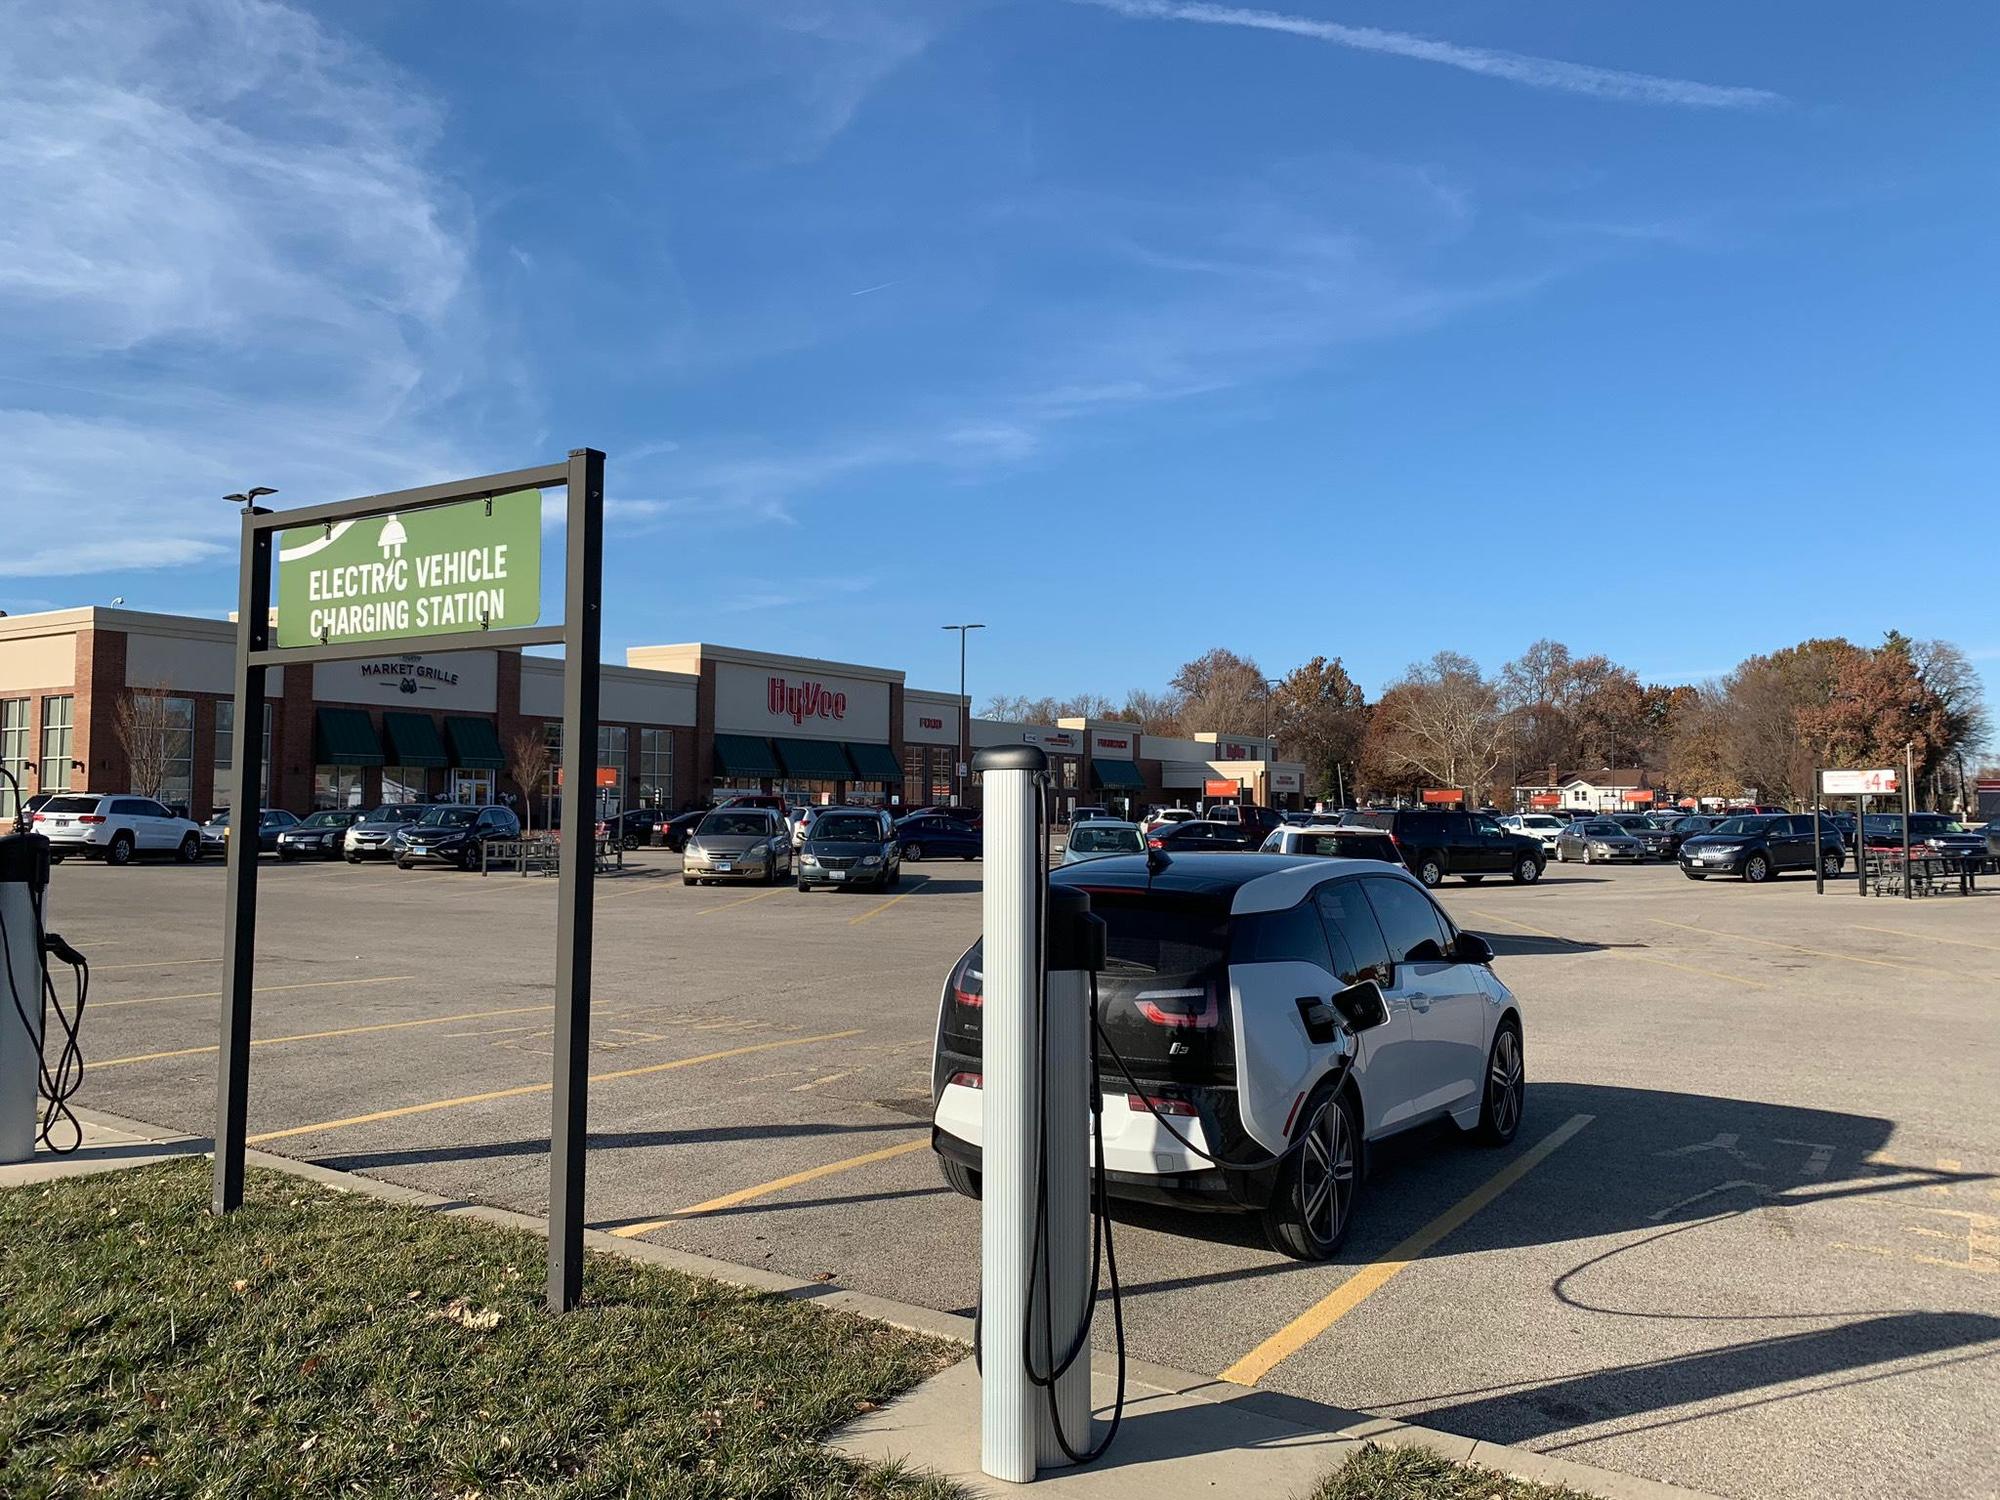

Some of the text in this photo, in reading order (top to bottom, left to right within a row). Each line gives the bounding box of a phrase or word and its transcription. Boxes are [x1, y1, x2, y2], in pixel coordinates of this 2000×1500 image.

[309, 545, 508, 600] ELECTRIC VEHICLE
[310, 588, 505, 637] CHARGING STATION
[361, 663, 460, 685] MARKET GRILLE
[1169, 1041, 1189, 1056] i3
